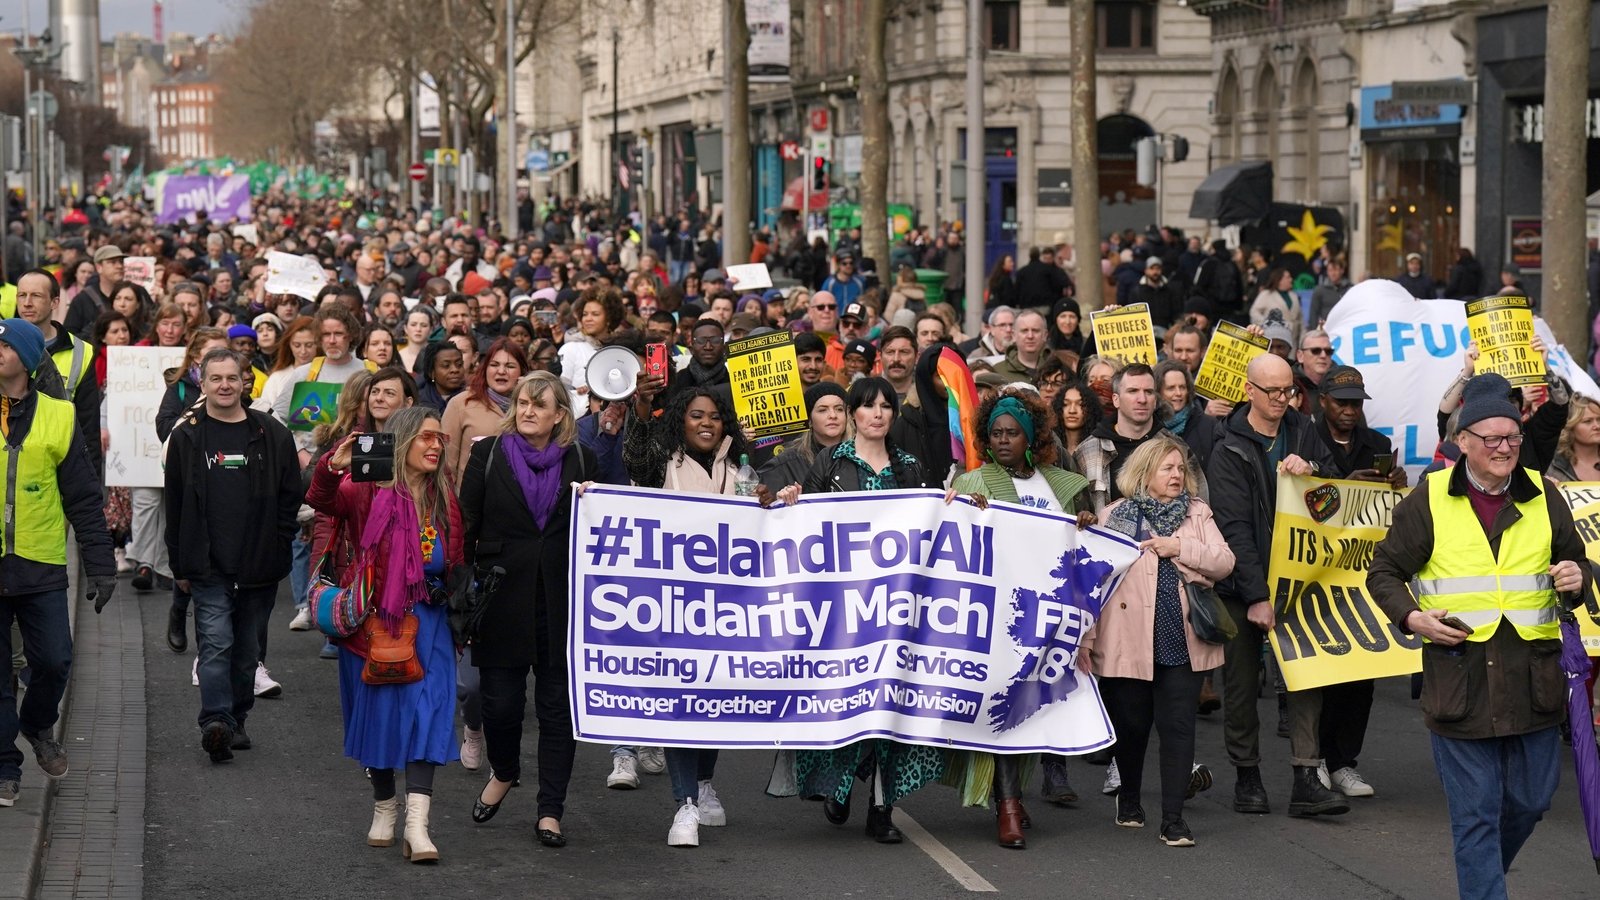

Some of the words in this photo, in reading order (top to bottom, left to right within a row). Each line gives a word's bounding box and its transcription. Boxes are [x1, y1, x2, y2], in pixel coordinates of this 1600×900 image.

[1488, 311, 1499, 322] NO
[1503, 310, 1512, 320] TO
[1097, 319, 1148, 335] REFUGEES
[1473, 326, 1488, 338] FAR
[1491, 321, 1513, 334] RIGHT
[1516, 320, 1531, 330] LIES
[728, 342, 747, 353] UNITED
[747, 338, 768, 349] AGAINST
[768, 333, 789, 344] RACISM
[1100, 334, 1151, 352] WELCOME
[1480, 335, 1496, 348] AND
[1499, 332, 1529, 343] RACISM
[748, 353, 758, 365] NO
[762, 351, 771, 363] TO
[1212, 353, 1226, 366] AND
[1227, 359, 1247, 373] RACIS
[1489, 349, 1509, 364] YES
[1513, 347, 1526, 360] TO
[733, 369, 747, 382] FAR
[750, 363, 772, 378] RIGHT
[775, 360, 793, 373] LIES
[1212, 367, 1228, 382] YES
[1230, 374, 1242, 388] TO
[740, 380, 755, 393] AND
[758, 373, 789, 390] RACISM
[1198, 375, 1247, 401] SOLIDARITY
[748, 395, 768, 412] YES
[772, 391, 786, 408] TO
[1316, 486, 1339, 499] UNITED
[586, 515, 994, 578] #IrelandForAll
[1288, 526, 1317, 565] IT'S
[1322, 535, 1334, 567] A
[1335, 538, 1376, 571] HOUS
[590, 583, 832, 647] Solidarity
[843, 584, 989, 638] March
[584, 648, 698, 684] Housing
[705, 654, 719, 683] /
[728, 653, 869, 680] Healthcare
[873, 644, 888, 673] /
[896, 645, 988, 682] Services
[589, 689, 678, 716] Stronger
[682, 694, 776, 718] Together
[779, 695, 792, 718] /
[796, 688, 880, 715] Diversity
[904, 688, 977, 716] Division
